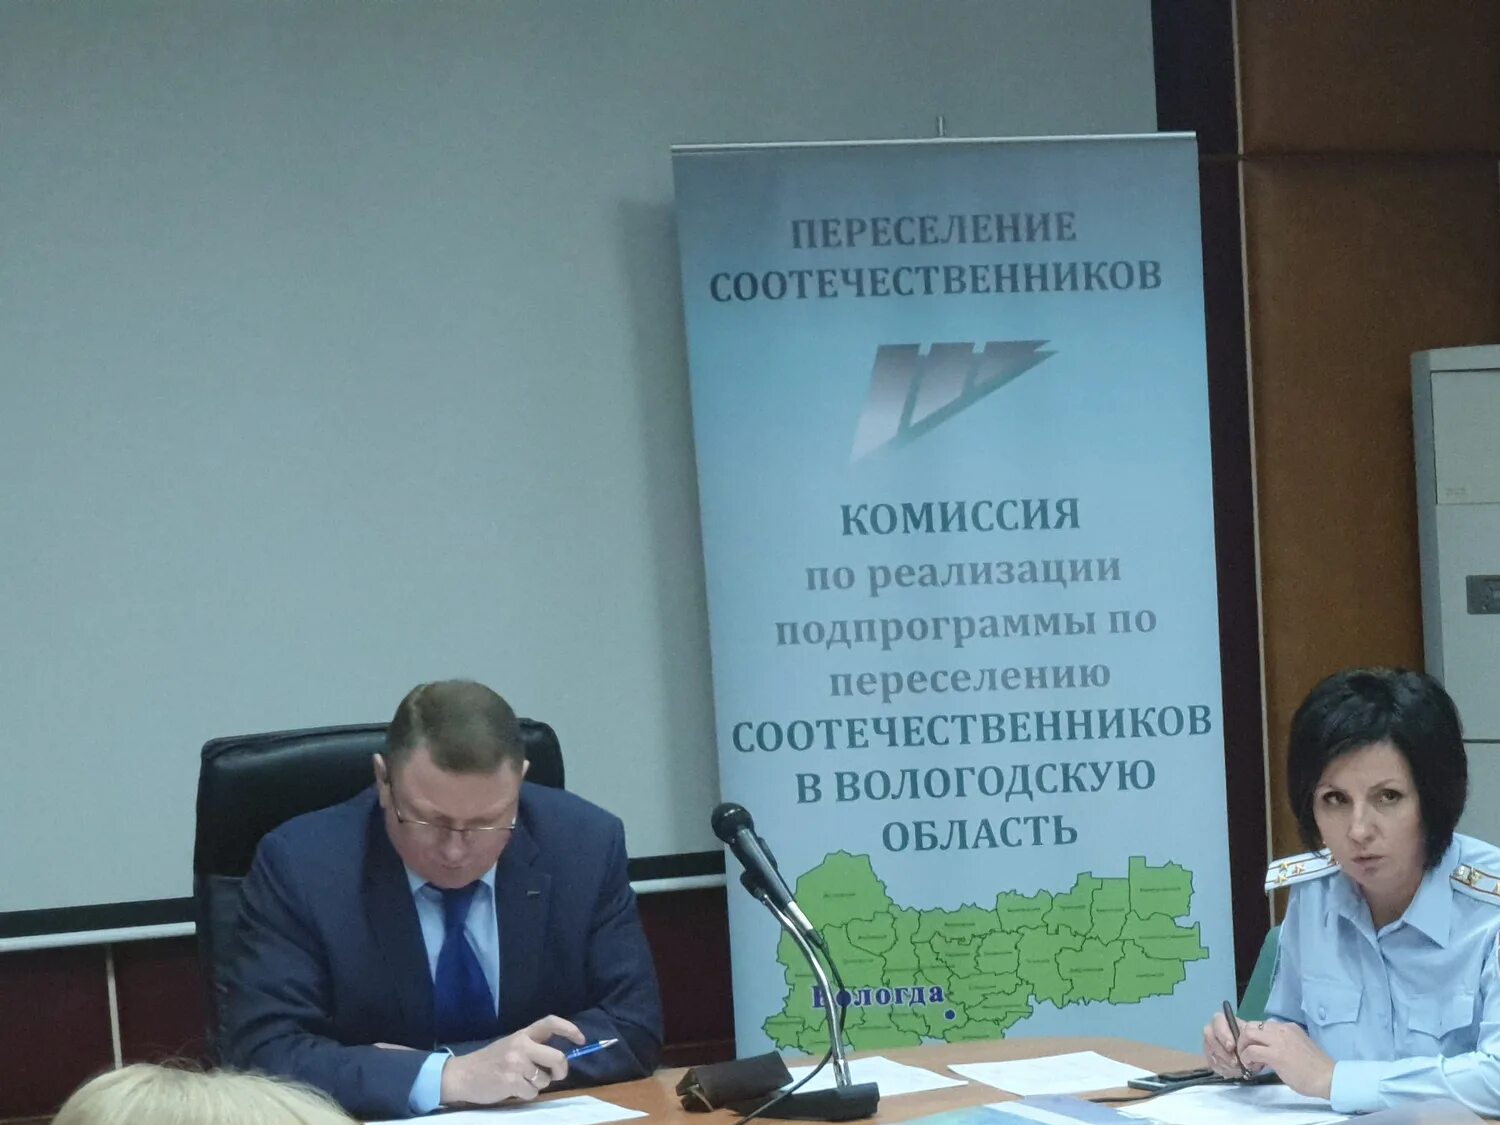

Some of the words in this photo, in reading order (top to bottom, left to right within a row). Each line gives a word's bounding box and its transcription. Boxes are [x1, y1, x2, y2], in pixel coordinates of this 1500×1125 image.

[791, 211, 1077, 249] ПЕРЕСЕЛЕНИЕ
[709, 260, 1162, 302] СООТЕЧЕСТВЕННИКОВ
[840, 497, 1080, 536] КОМИССИЯ
[806, 566, 856, 591] по
[867, 557, 1122, 597] реализации
[775, 611, 1097, 651] подпрограммы
[1108, 609, 1157, 635] по
[829, 662, 1111, 703] переселению
[732, 704, 1212, 753] СООТЕЧЕСТВЕННИКОВ
[796, 772, 823, 804] В
[835, 759, 1156, 802] ВОЛОГОДСКУЮ
[882, 814, 1078, 852] ОБЛАСТЬ
